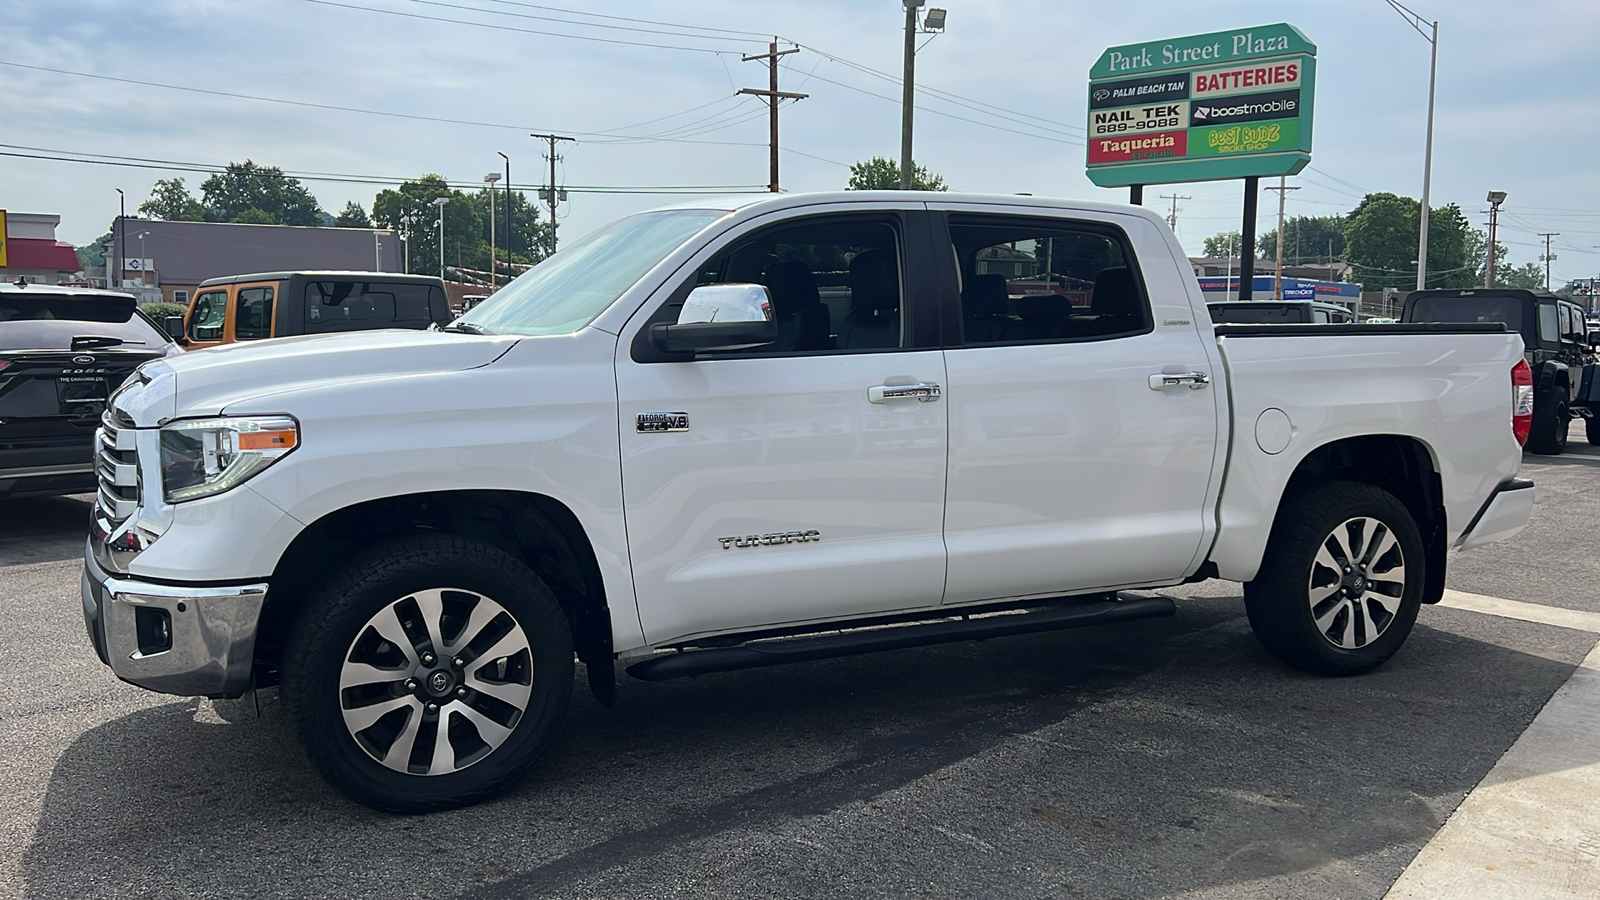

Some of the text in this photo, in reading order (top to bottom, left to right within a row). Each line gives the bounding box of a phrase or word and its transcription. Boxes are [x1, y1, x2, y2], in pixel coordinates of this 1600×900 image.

[1108, 32, 1289, 72] Park Street Plaza
[1196, 64, 1298, 92] BATTERIES
[1112, 81, 1185, 98] PALM BEACH TAN
[1095, 104, 1181, 124] NAIL TEK
[1096, 118, 1179, 134] 689-9088
[1242, 123, 1281, 145] BUDZ
[1218, 142, 1269, 153] SMOKE SHOP
[668, 415, 688, 429] V8
[717, 530, 820, 550] TUNDRA
